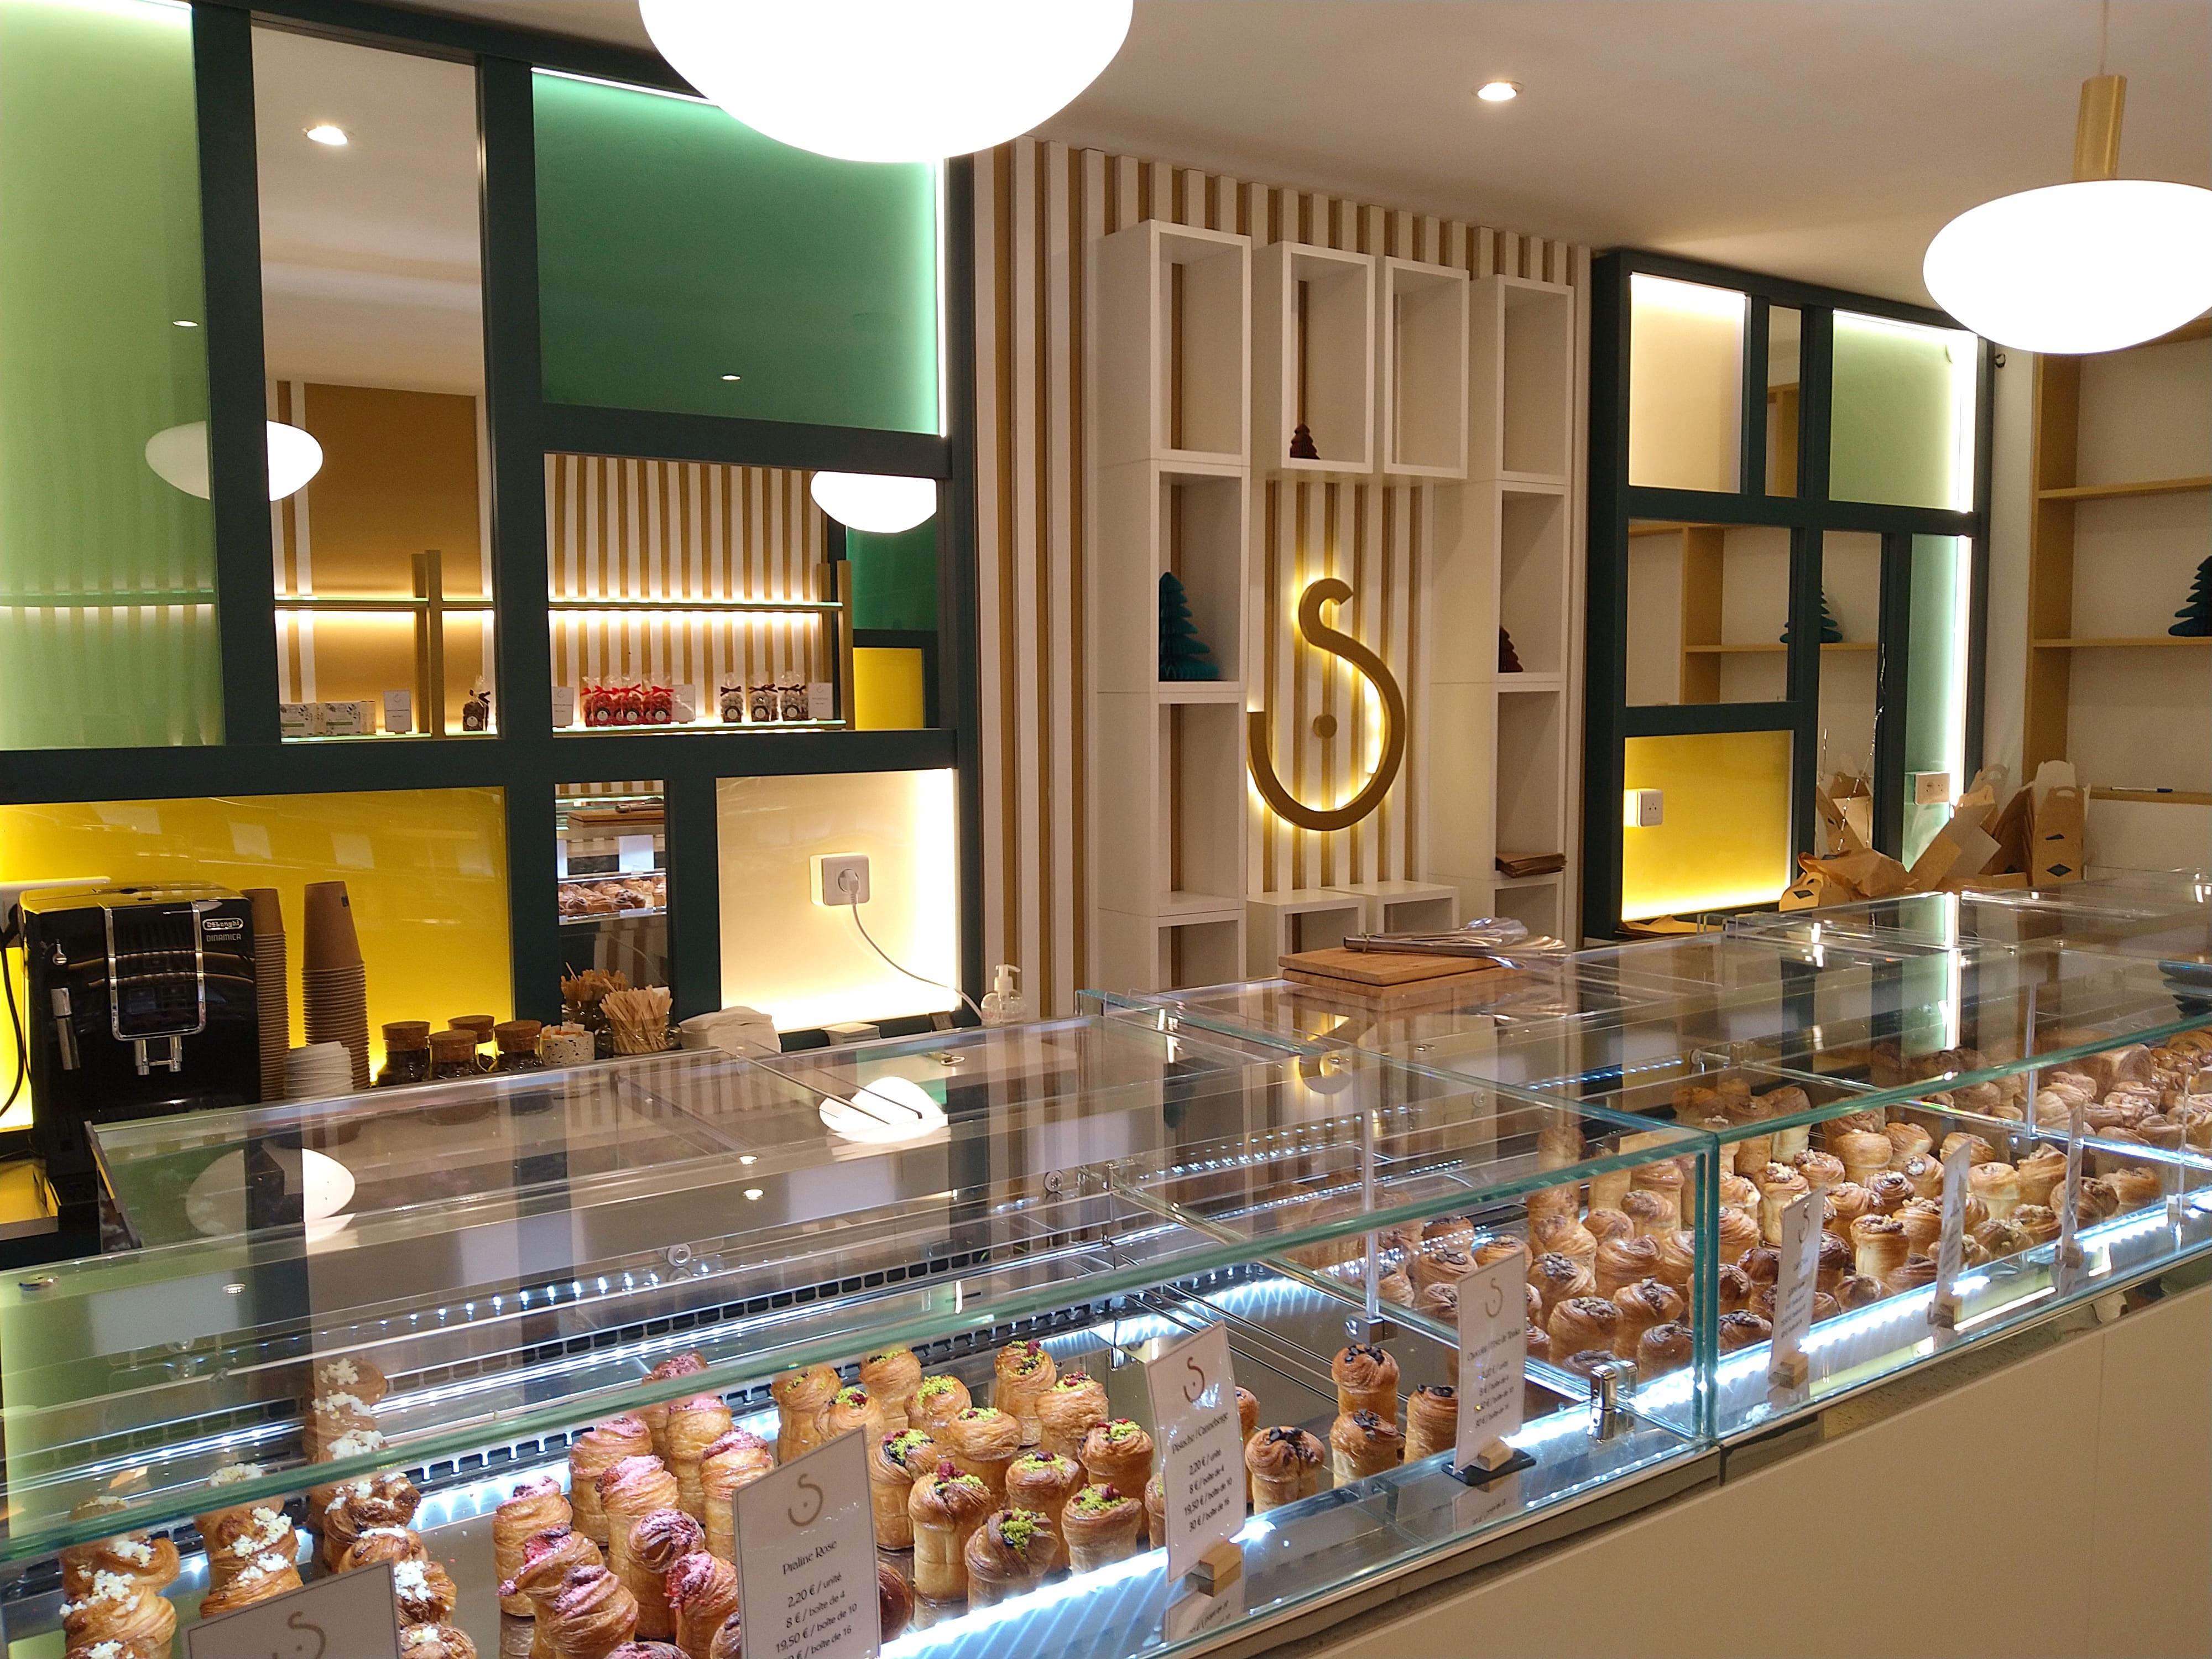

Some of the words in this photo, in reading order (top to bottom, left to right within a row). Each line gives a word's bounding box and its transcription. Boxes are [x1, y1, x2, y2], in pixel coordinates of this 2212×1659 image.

[206, 933, 242, 942] DINAMICA
[782, 1553, 813, 1574] Praline
[815, 1541, 837, 1558] Rose
[787, 1589, 807, 1608] 2,20
[810, 1584, 816, 1595] €
[823, 1572, 842, 1588] unité
[776, 1632, 801, 1653] 19,50
[802, 1627, 808, 1639] €
[817, 1616, 836, 1631] boîte
[837, 1610, 847, 1620] de
[848, 1603, 857, 1614] 10
[786, 1617, 792, 1628] 8
[795, 1612, 801, 1623] €
[809, 1601, 828, 1616] boîte
[830, 1595, 839, 1605] de
[811, 1639, 830, 1654] boîte
[832, 1632, 841, 1643] de
[843, 1625, 852, 1635] 16
